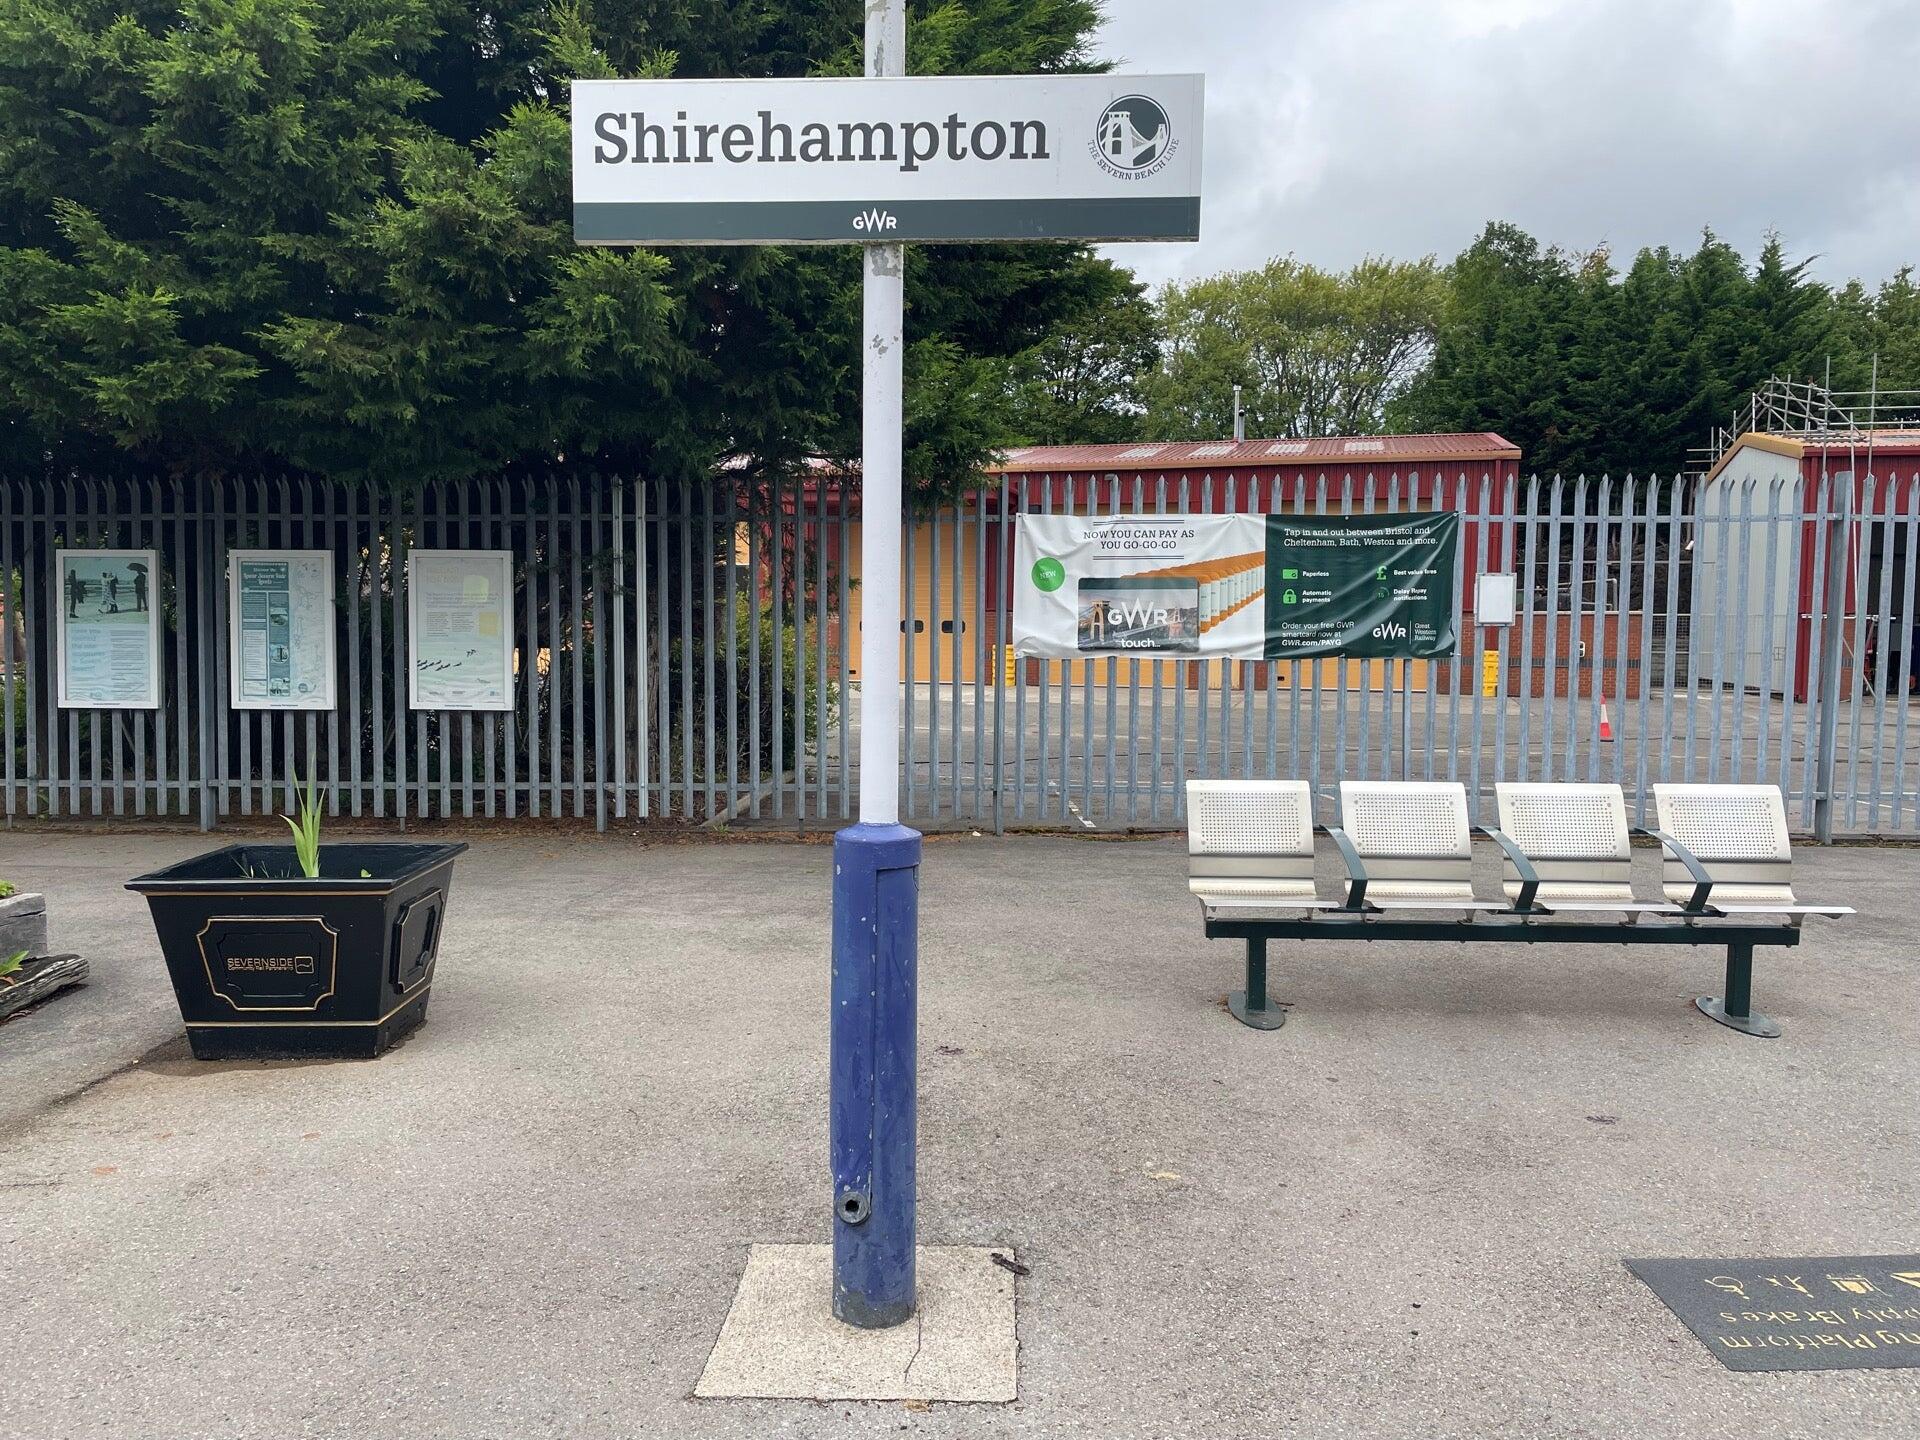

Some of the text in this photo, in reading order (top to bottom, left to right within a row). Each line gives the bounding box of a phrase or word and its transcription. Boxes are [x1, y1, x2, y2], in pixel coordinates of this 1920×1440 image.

[594, 110, 1050, 171] Shirehampton
[1087, 138, 1179, 180] THE SEVERN BEACH LINE
[852, 207, 897, 232] GWR
[1083, 529, 1195, 539] NOW YOU CAN PAY AS
[1284, 528, 1300, 537] Tap
[1302, 528, 1310, 536] in
[1346, 528, 1383, 536] between
[1385, 527, 1413, 535] Bristol
[1414, 526, 1430, 534] and
[1101, 540, 1177, 549] YOU GO-GO-GO
[1283, 537, 1438, 547] Cheltenham, Bath, Weston and more.
[1040, 570, 1056, 579] NEW
[1107, 597, 1168, 630] GWR
[1281, 621, 1301, 629] Order
[1320, 621, 1335, 629] free
[1336, 621, 1355, 629] GWR
[1372, 620, 1407, 640] GWR
[227, 957, 293, 967] SEVERNSIDE
[1719, 1310, 1847, 1325] Brakes
[1718, 1333, 1878, 1350] Platform
